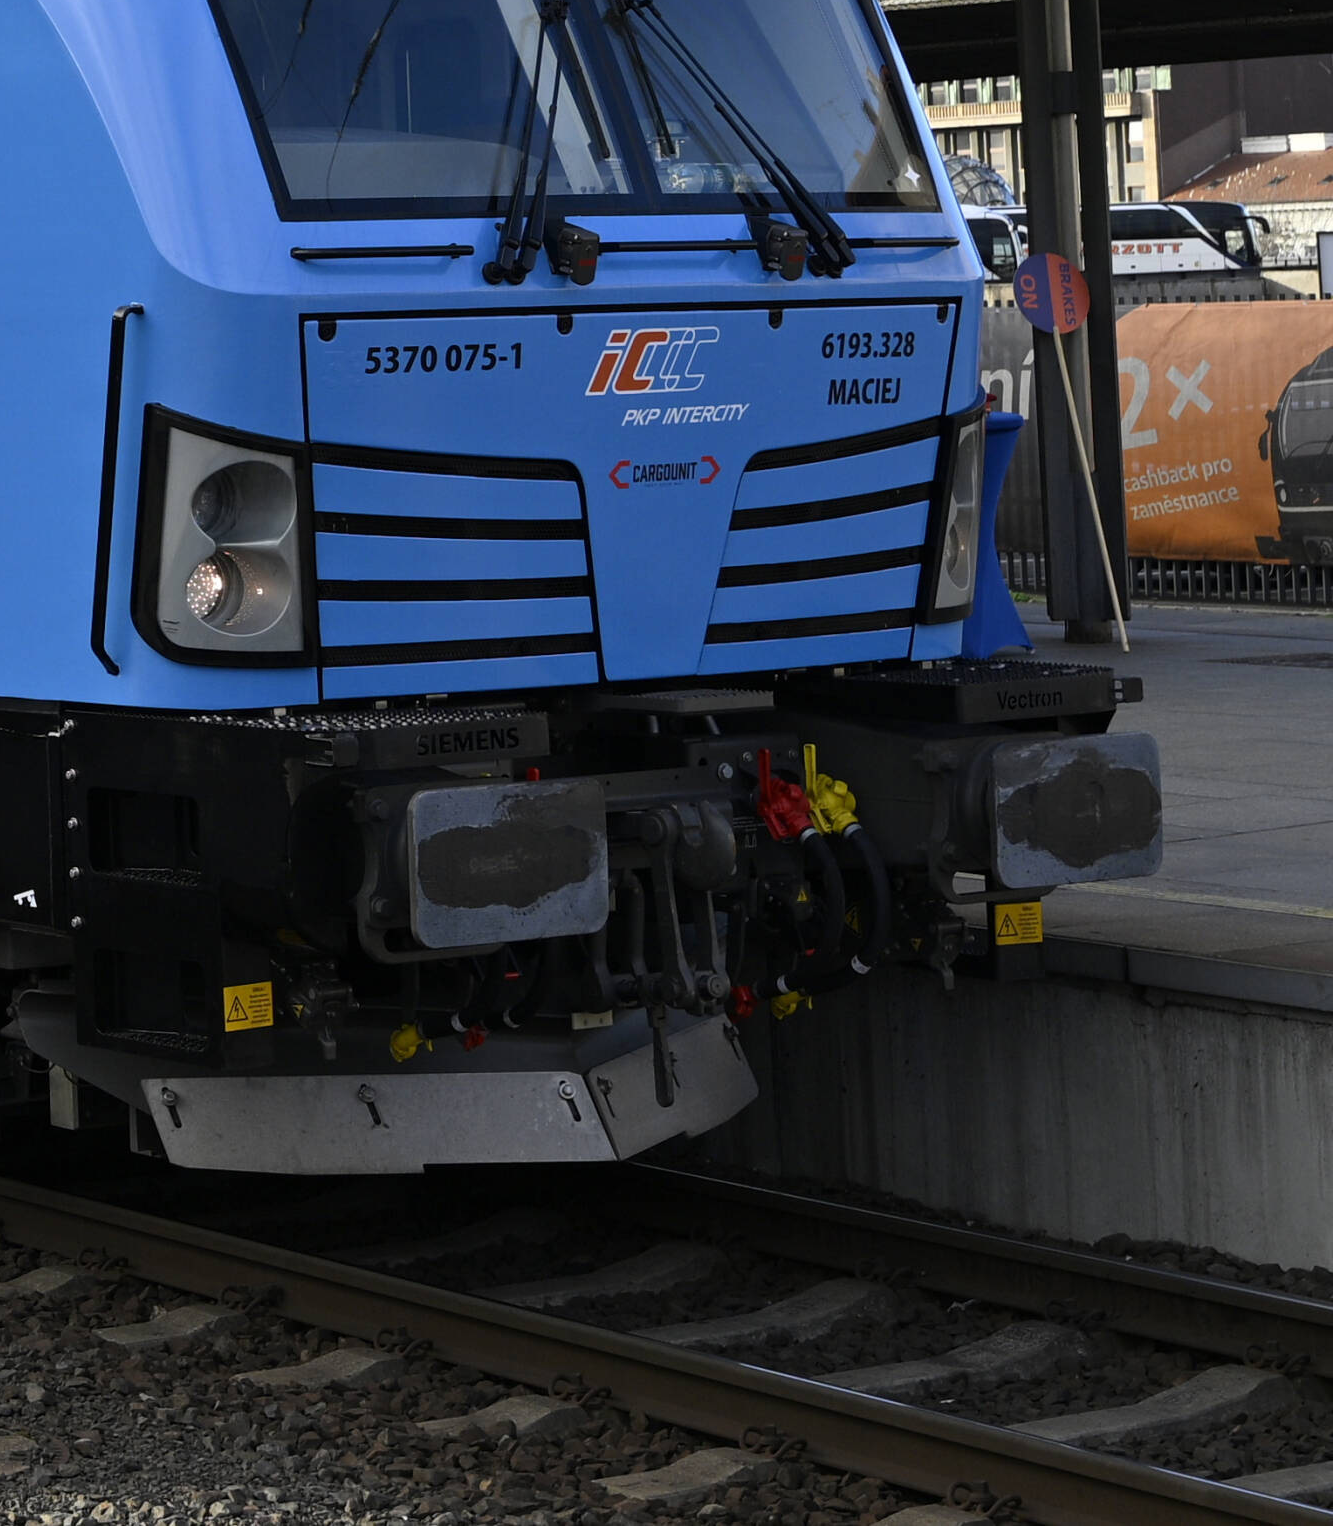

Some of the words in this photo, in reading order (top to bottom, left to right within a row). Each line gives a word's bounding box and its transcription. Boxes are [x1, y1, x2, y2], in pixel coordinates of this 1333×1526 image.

[1020, 275, 1039, 309] ON
[1059, 263, 1076, 325] BRAKES
[364, 345, 438, 374] 5370
[445, 343, 522, 372] 075-1
[821, 332, 915, 359] 6193.328
[827, 378, 901, 405] MACIEJ
[621, 408, 661, 426] PKP
[662, 403, 750, 425] INTERCITY
[633, 462, 698, 483] CARGOUNIT
[1124, 461, 1199, 492] cashback
[1201, 458, 1232, 482] pro
[1130, 485, 1240, 520] zaměstnance
[997, 690, 1062, 710] Vectron
[416, 727, 519, 756] SIEMENS
